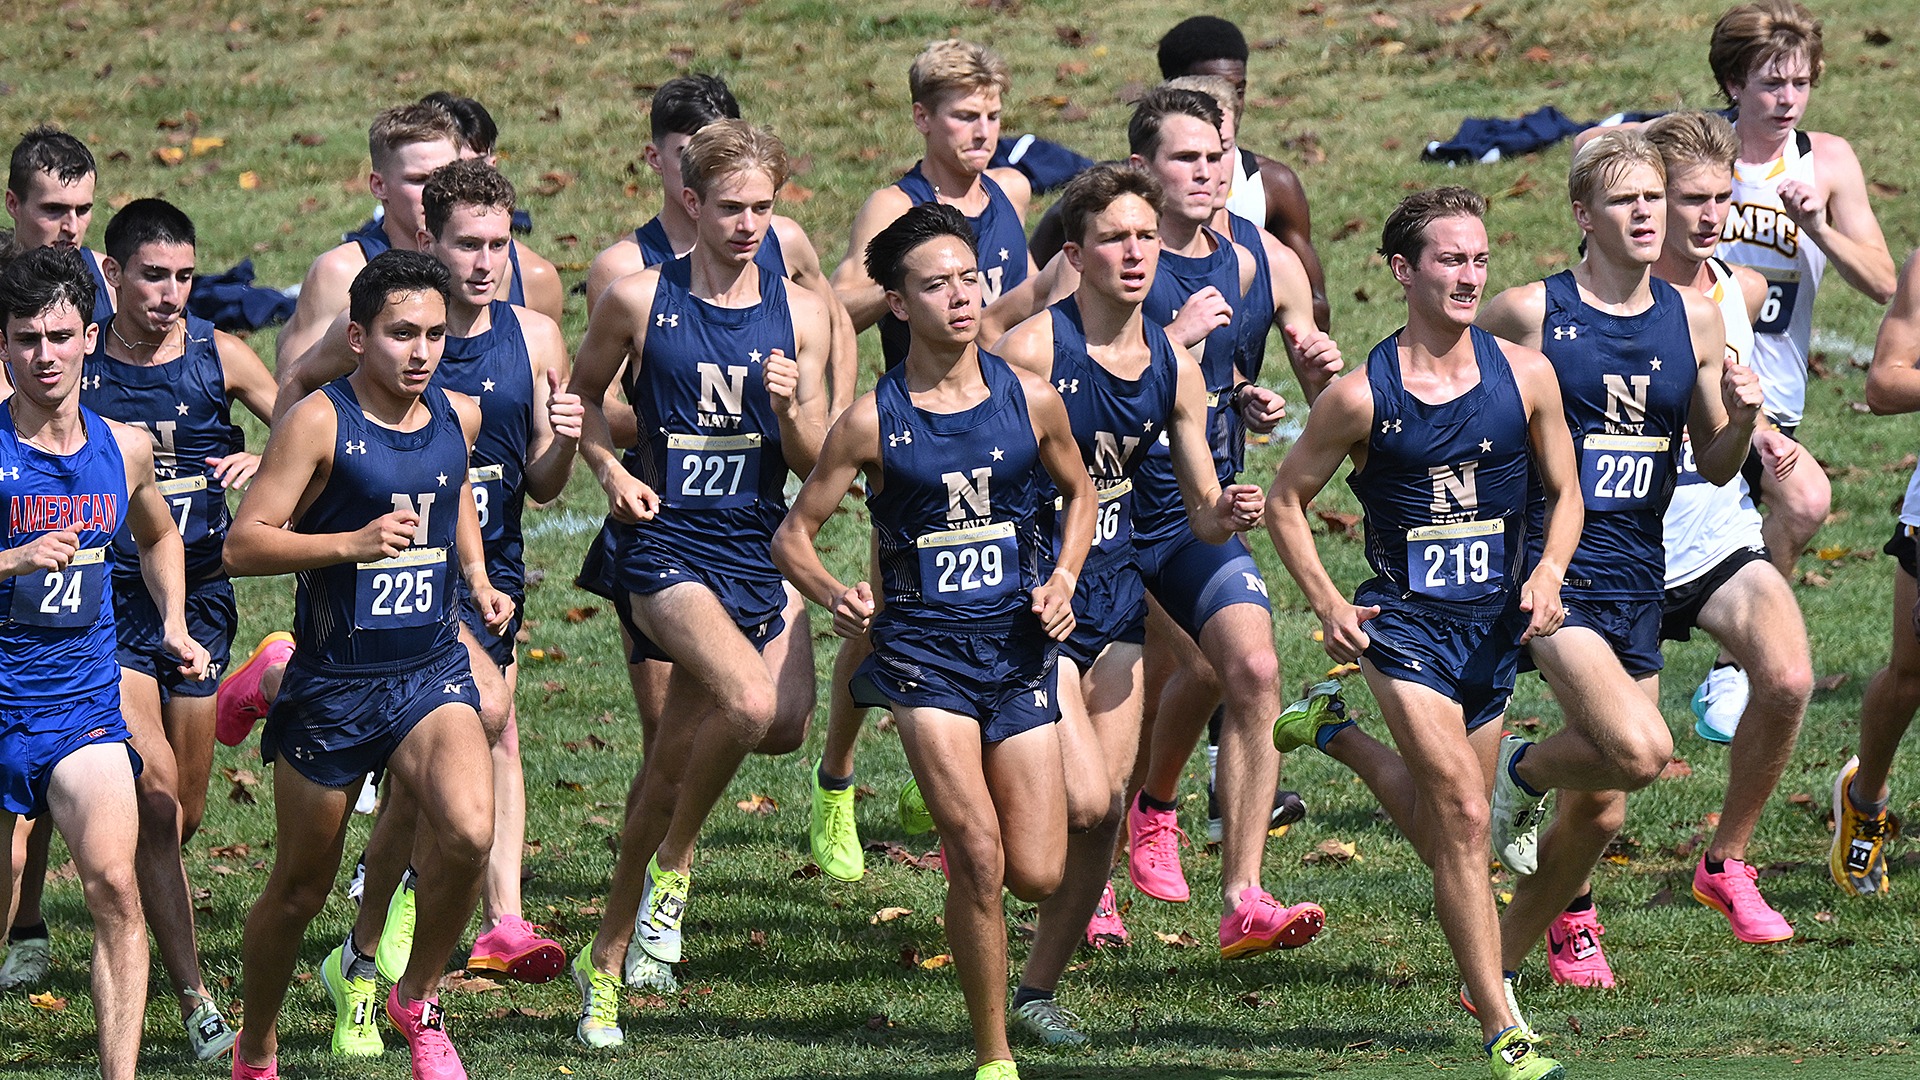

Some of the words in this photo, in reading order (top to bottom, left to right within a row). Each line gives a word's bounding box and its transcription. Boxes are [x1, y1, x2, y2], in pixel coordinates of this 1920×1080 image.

[697, 362, 748, 415] N
[1603, 374, 1650, 422] N
[697, 413, 743, 430] NAVY
[1604, 421, 1644, 436] NAVY
[682, 454, 746, 496] 227
[1089, 430, 1140, 477] N
[1594, 454, 1654, 499] 220
[941, 466, 992, 521] N
[1428, 459, 1479, 513] N
[8, 494, 118, 538] AMERICAN
[935, 544, 1003, 592] 229
[1423, 540, 1489, 588] 219
[40, 570, 82, 614] 24
[371, 569, 433, 616] 225
